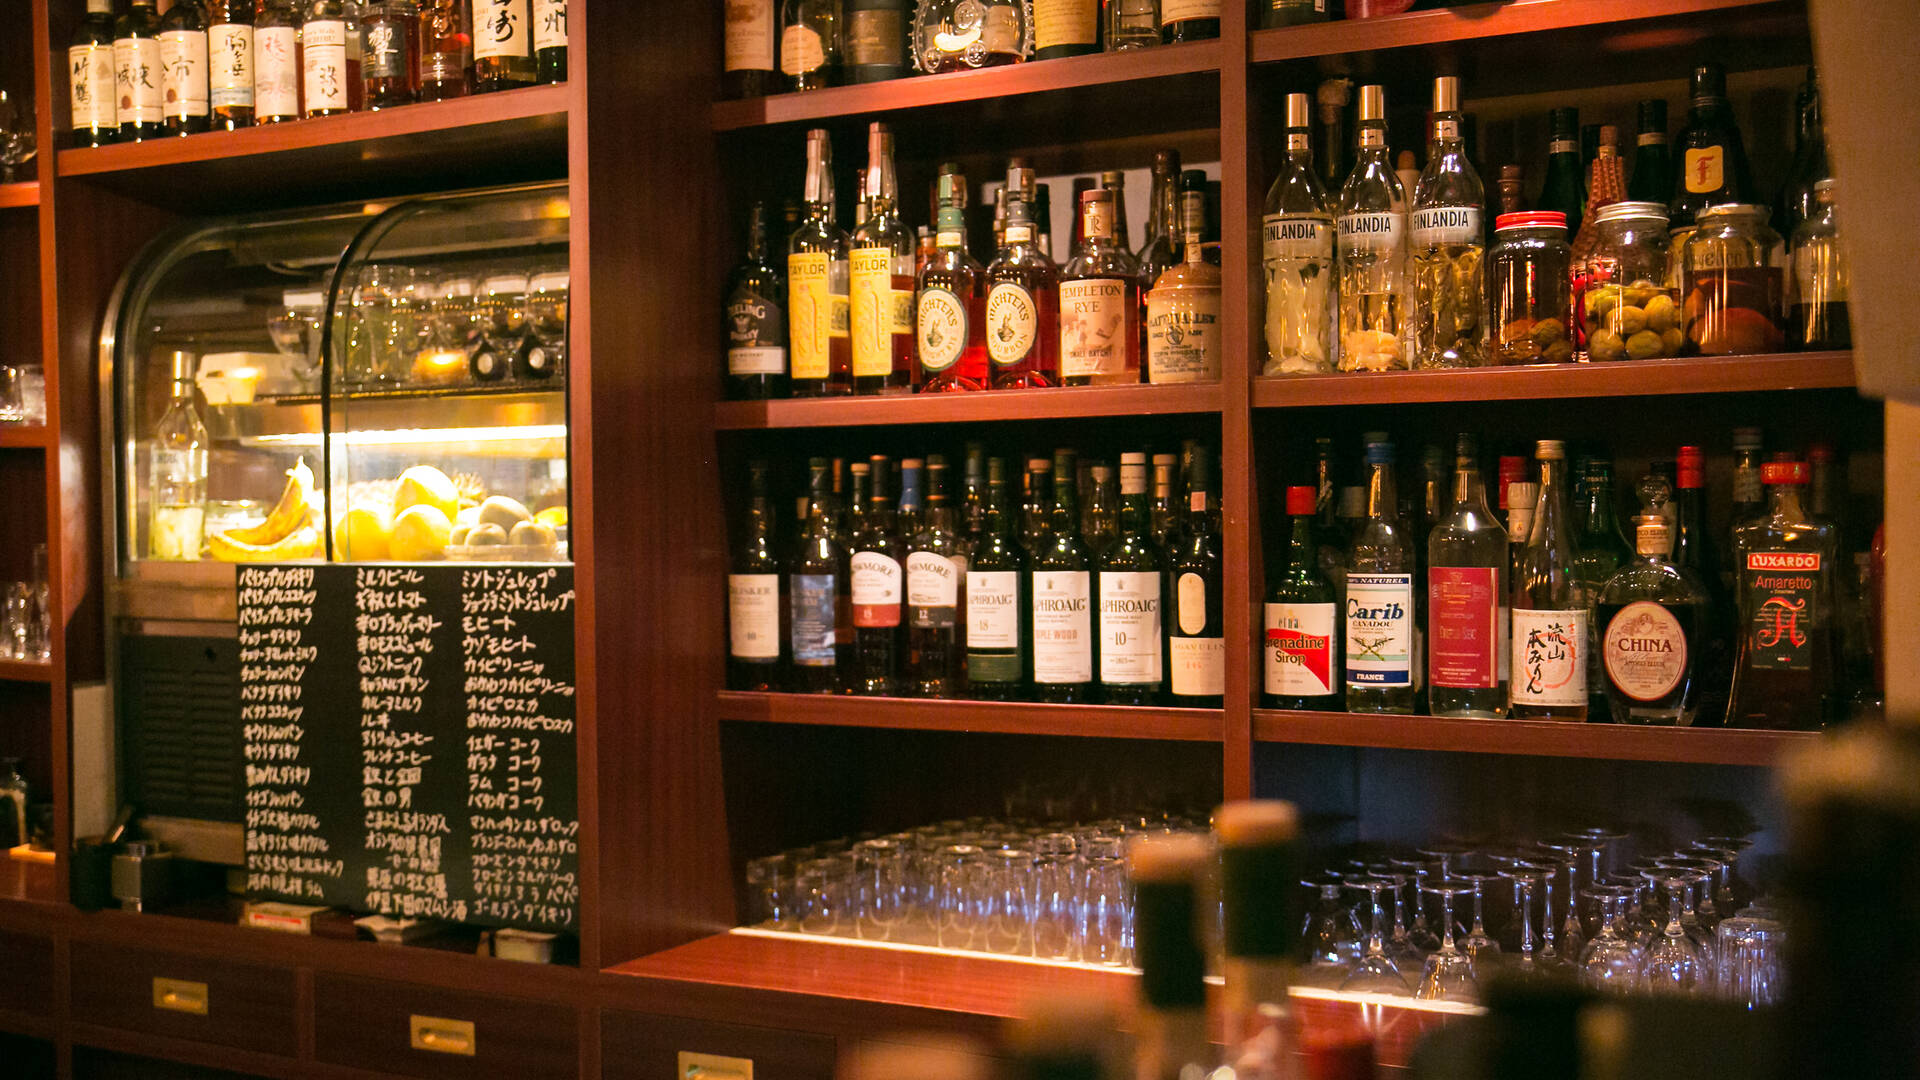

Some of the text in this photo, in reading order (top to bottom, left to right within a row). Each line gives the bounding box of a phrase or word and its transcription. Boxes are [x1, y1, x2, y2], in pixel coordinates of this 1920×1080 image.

[368, 26, 398, 65] 響
[1338, 217, 1391, 236] FINLANDIA
[1414, 211, 1469, 231] FINLANDIA
[1264, 223, 1316, 241] FINLANDIA
[1062, 284, 1121, 299] TEMPLETON
[1074, 301, 1100, 313] RYE
[1751, 555, 1816, 568] LUXARDO
[356, 567, 425, 589] ミルクビール
[462, 568, 557, 592] ミントジュレップ
[1755, 575, 1813, 590] Amaretto
[1347, 598, 1404, 620] Carib
[462, 615, 517, 633] モヒート
[462, 634, 537, 655] ウゾモヒート
[1114, 632, 1127, 646] 10
[1547, 622, 1566, 661] 流山
[1618, 638, 1673, 653] CHINA
[464, 656, 545, 675] カイピリーニャ
[1275, 649, 1306, 666] Sirop
[1526, 628, 1547, 695] 本みりん
[1356, 673, 1385, 681] FRANCE
[466, 695, 539, 714] カイピロスカ
[510, 737, 541, 755] コーク
[508, 755, 542, 773] コーク
[469, 774, 543, 793] ラム コーク
